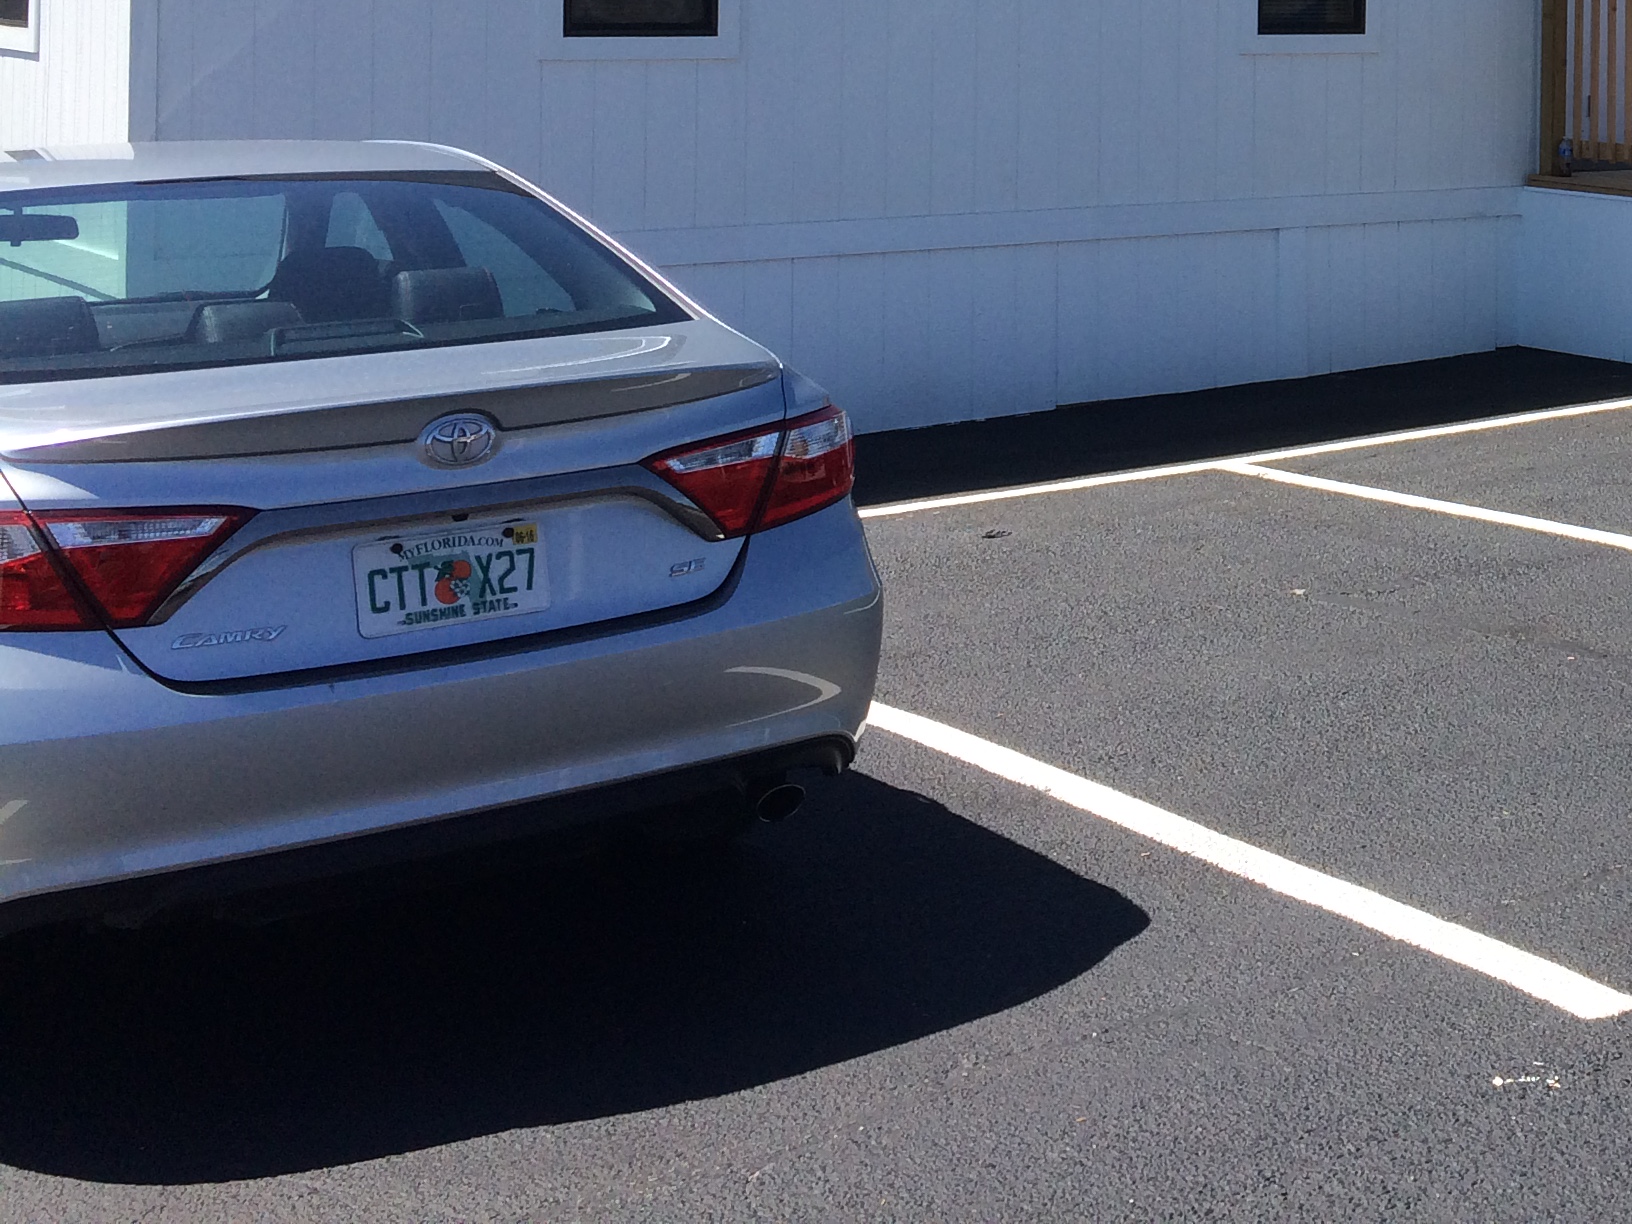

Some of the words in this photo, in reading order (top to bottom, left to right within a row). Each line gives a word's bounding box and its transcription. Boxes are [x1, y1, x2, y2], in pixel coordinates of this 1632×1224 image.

[400, 534, 504, 561] MYFLORIDA.COM
[367, 561, 431, 614] CTT
[474, 547, 535, 598] X27
[669, 557, 706, 577] SE
[405, 603, 466, 625] SUNSHINE
[473, 597, 511, 615] STATE
[171, 624, 288, 650] CAMRY
